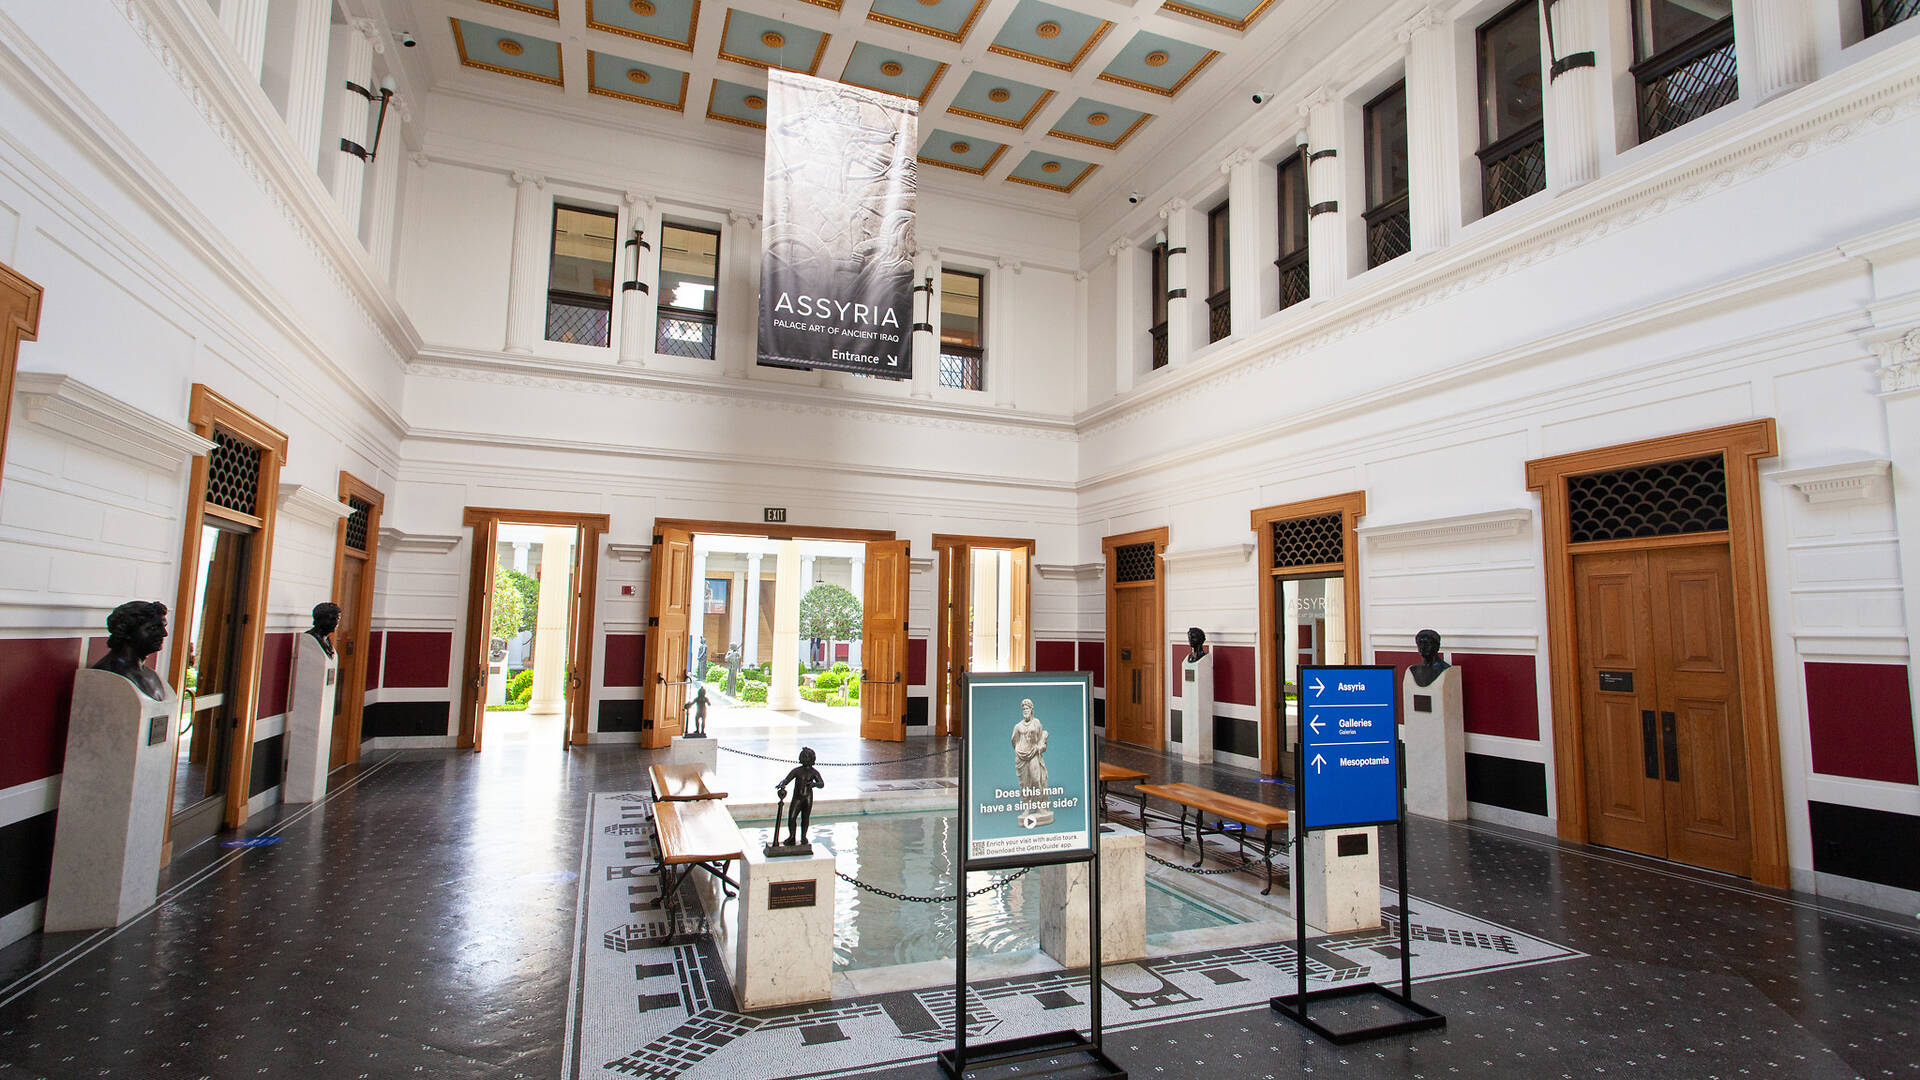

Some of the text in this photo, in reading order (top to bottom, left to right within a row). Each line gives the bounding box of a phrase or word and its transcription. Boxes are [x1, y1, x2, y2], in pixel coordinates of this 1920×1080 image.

[774, 292, 899, 328] ASSYRIA
[774, 319, 899, 343] PALACE ART OF ANCIENT IRAQ
[832, 349, 879, 364] Entrance
[768, 510, 784, 520] EXIT
[1287, 597, 1340, 609] ASSYR
[1338, 682, 1365, 693] Assyria
[1338, 718, 1372, 728] Galleries
[1340, 756, 1389, 769] Mesopotamia
[995, 786, 1064, 799] Does this man
[980, 802, 1004, 813] have
[1014, 800, 1051, 810] sinister
[1053, 798, 1078, 809] side?
